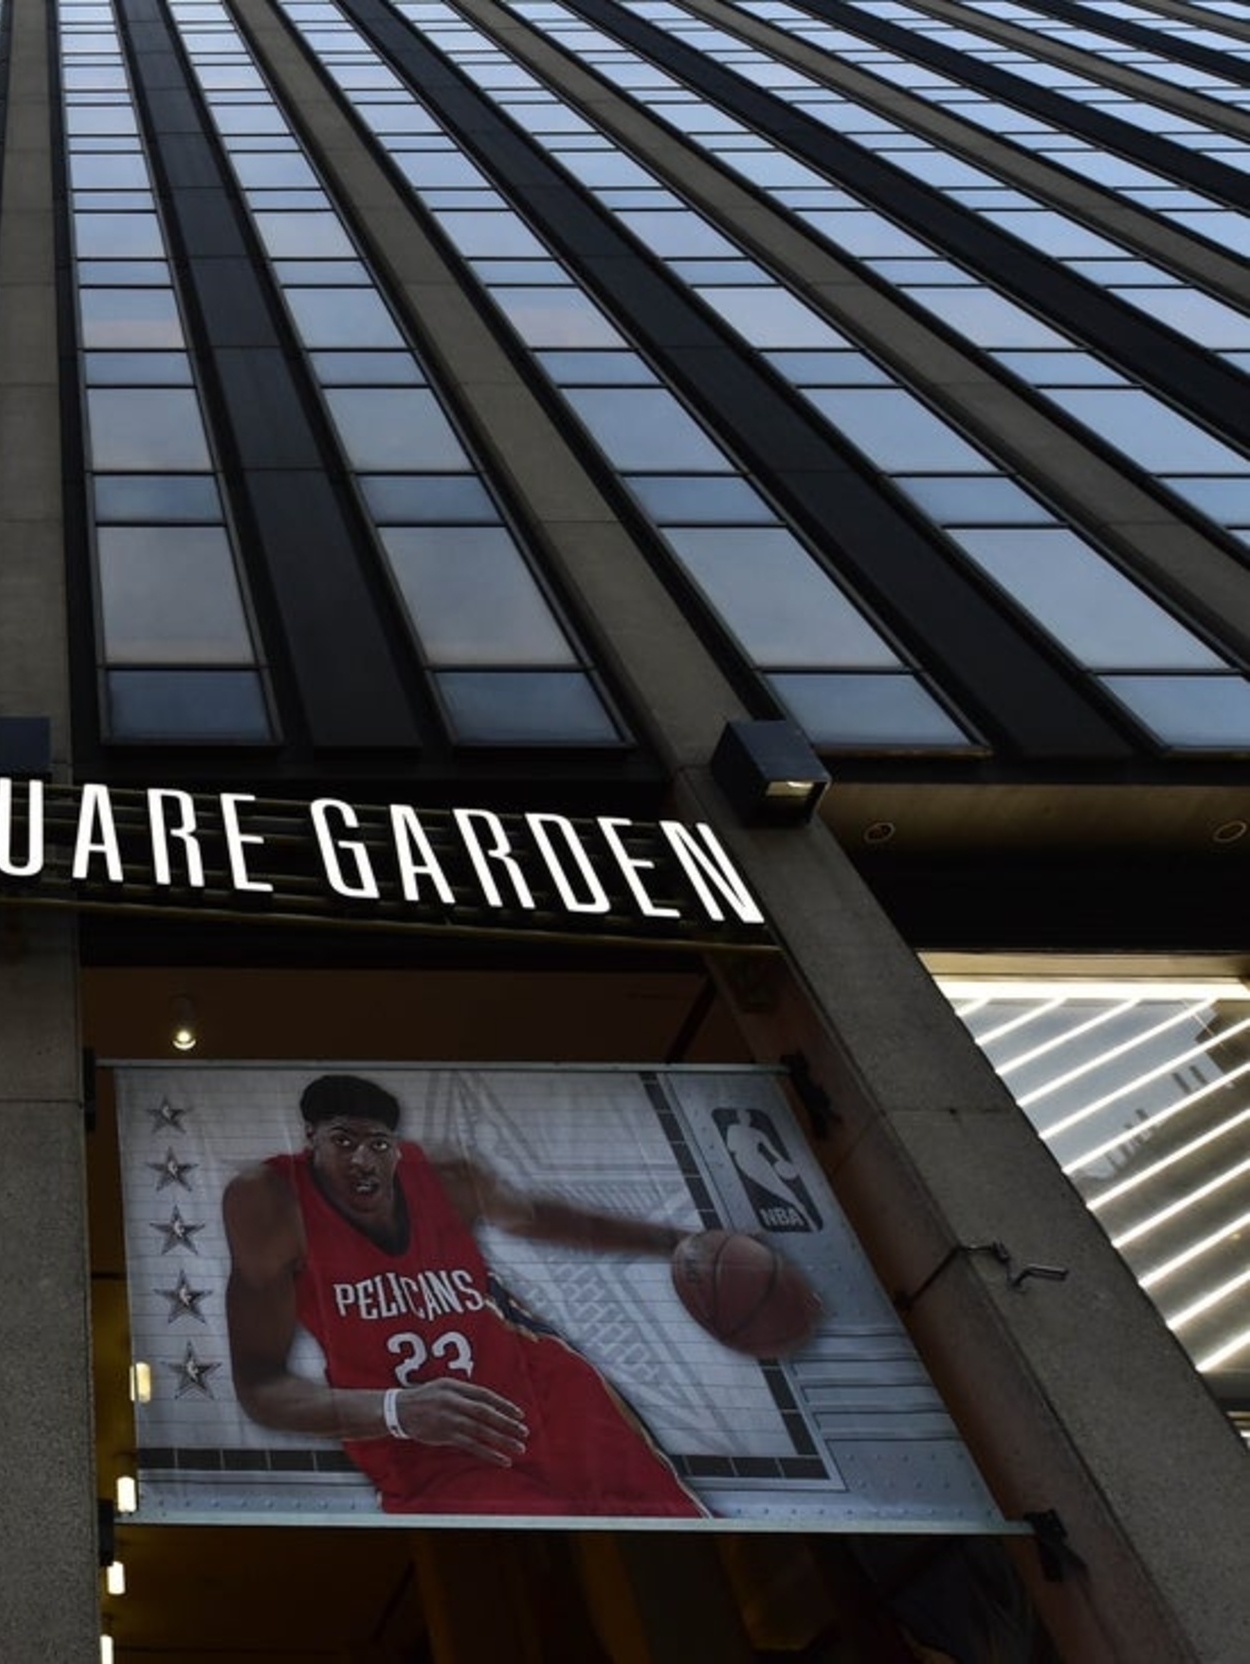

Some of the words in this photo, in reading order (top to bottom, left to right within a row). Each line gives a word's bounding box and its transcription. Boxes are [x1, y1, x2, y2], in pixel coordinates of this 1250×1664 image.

[310, 798, 765, 923] GARDEN
[759, 1206, 804, 1227] NBA
[332, 1269, 485, 1322] PELICANS
[386, 1330, 474, 1389] 23
